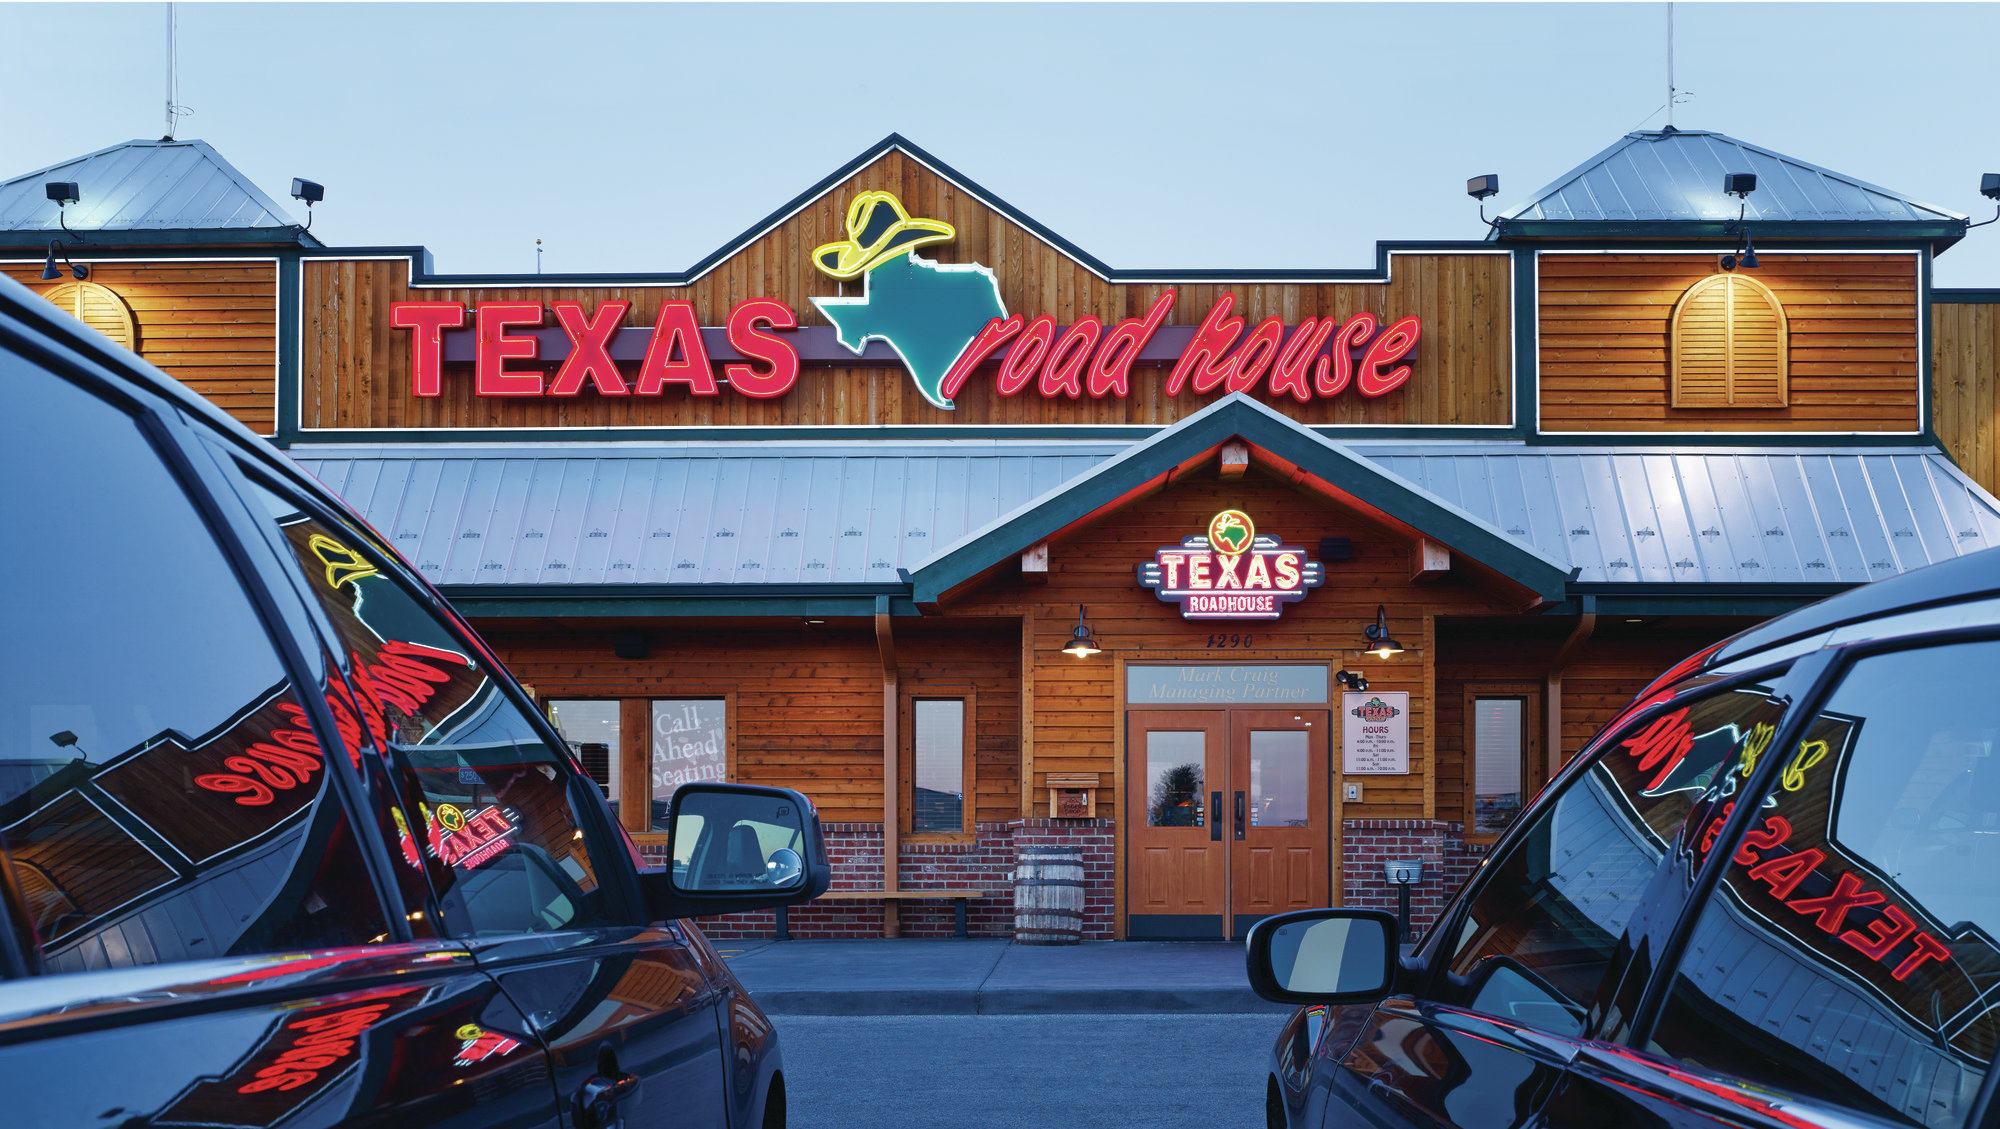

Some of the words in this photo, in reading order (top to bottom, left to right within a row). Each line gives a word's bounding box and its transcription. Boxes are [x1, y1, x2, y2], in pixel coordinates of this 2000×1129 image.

[390, 298, 800, 399] TEXAS
[942, 289, 1176, 399] road
[1164, 291, 1421, 402] house
[1161, 553, 1300, 590] TEXAS
[1189, 596, 1274, 612] ROADHOUSE
[1206, 633, 1253, 648] 1290
[1177, 667, 1223, 682] Mark
[1230, 667, 1279, 685] Craig
[1150, 683, 1237, 702] Managing
[1243, 684, 1310, 699] Partner
[656, 705, 702, 735] Call
[1360, 707, 1393, 716] TEXAS
[652, 729, 718, 763] Ahead
[652, 761, 726, 788] Seating
